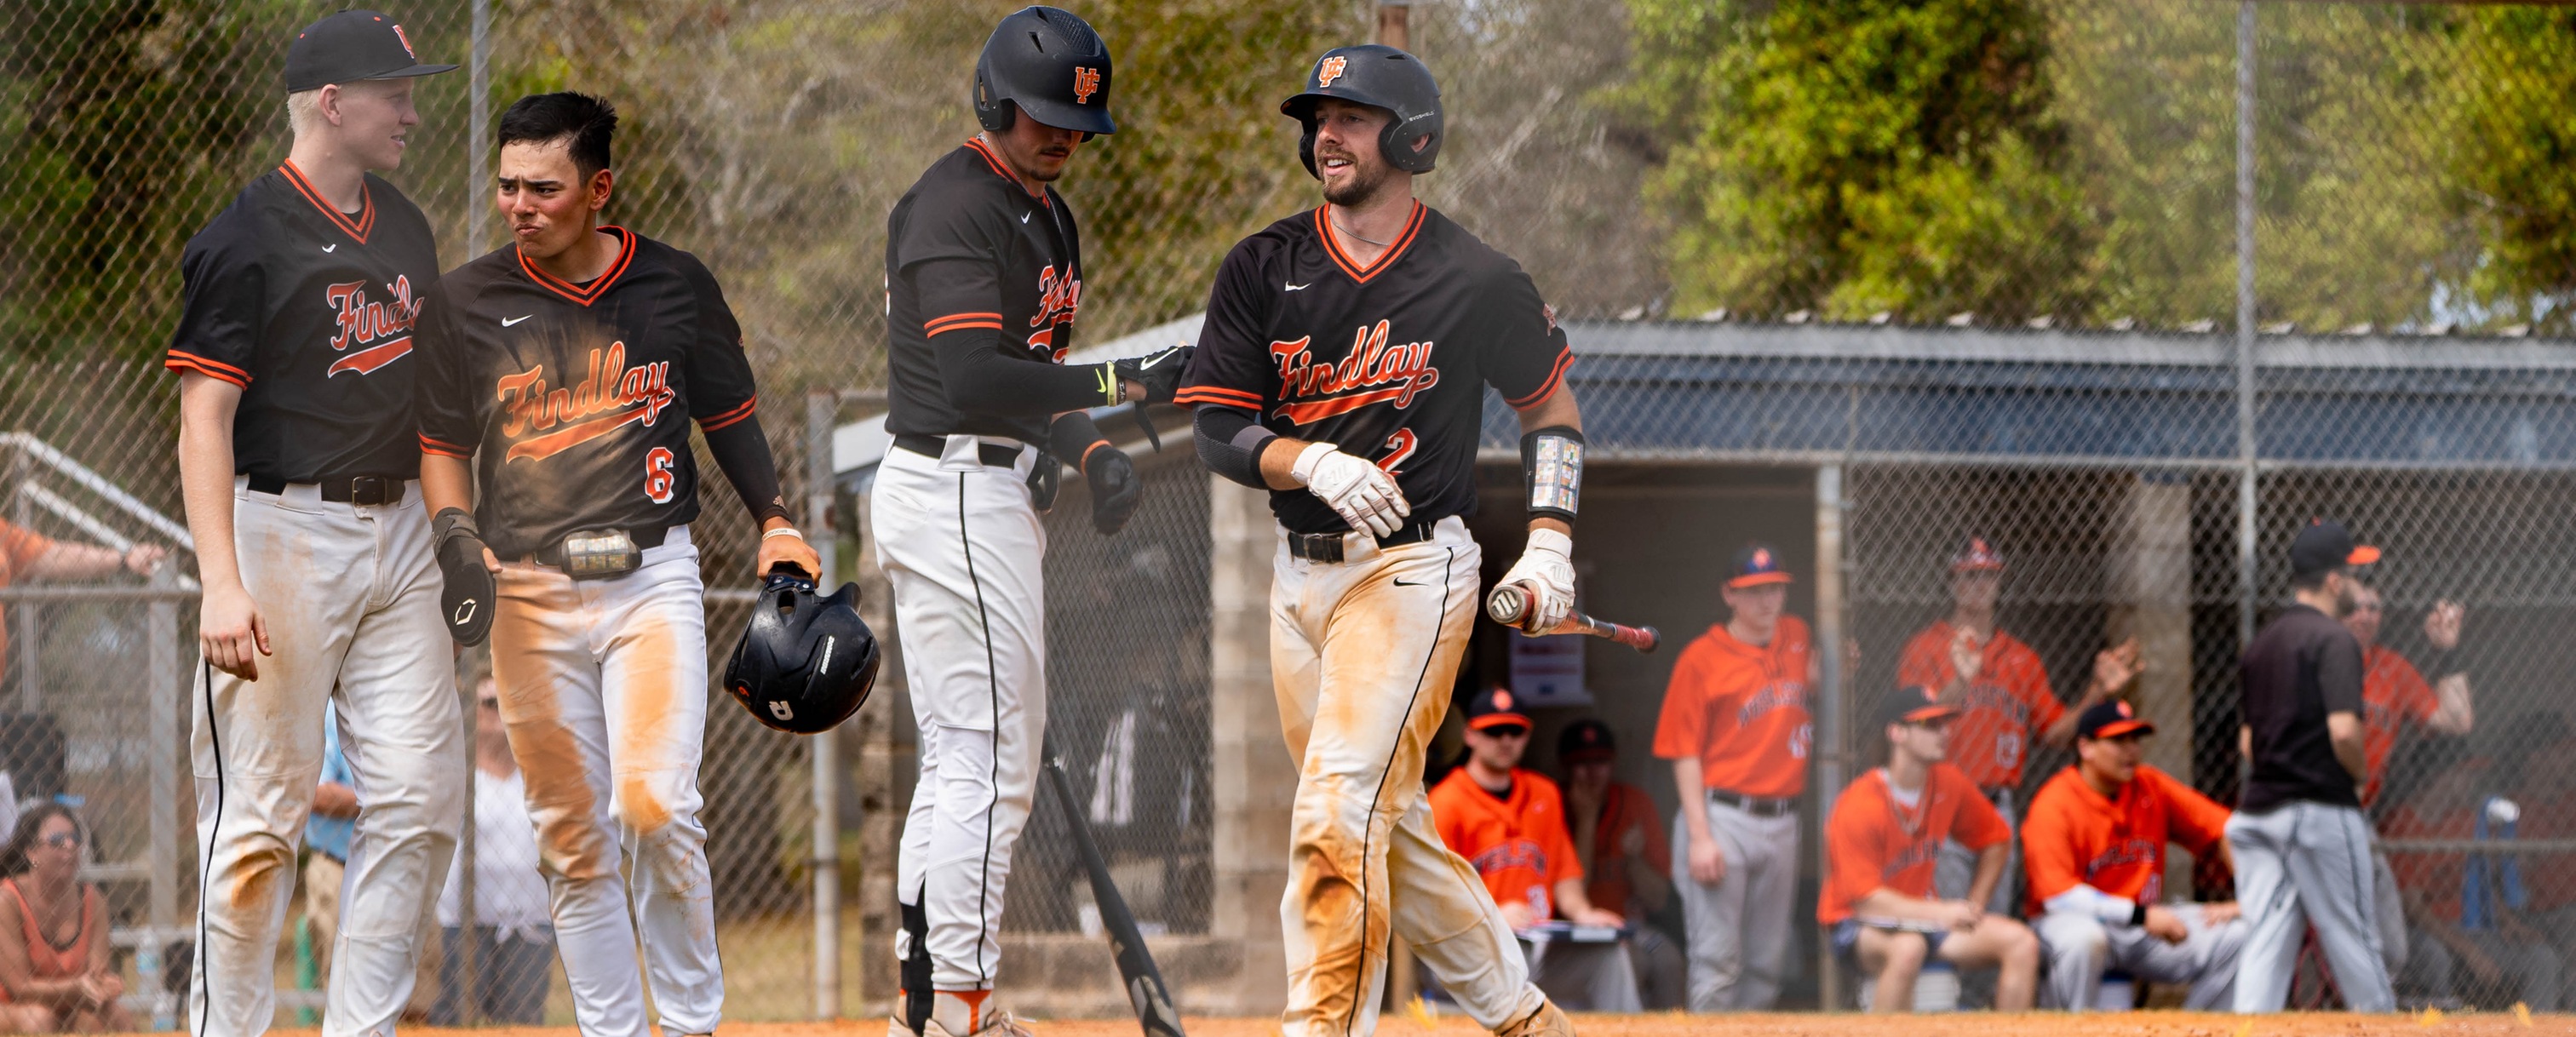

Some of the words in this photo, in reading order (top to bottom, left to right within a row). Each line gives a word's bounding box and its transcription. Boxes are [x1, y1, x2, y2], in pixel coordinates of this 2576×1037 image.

[497, 341, 675, 438] Findlay
[1270, 319, 1439, 410] Findlay
[645, 446, 674, 504] 6
[1376, 427, 1419, 478] 2
